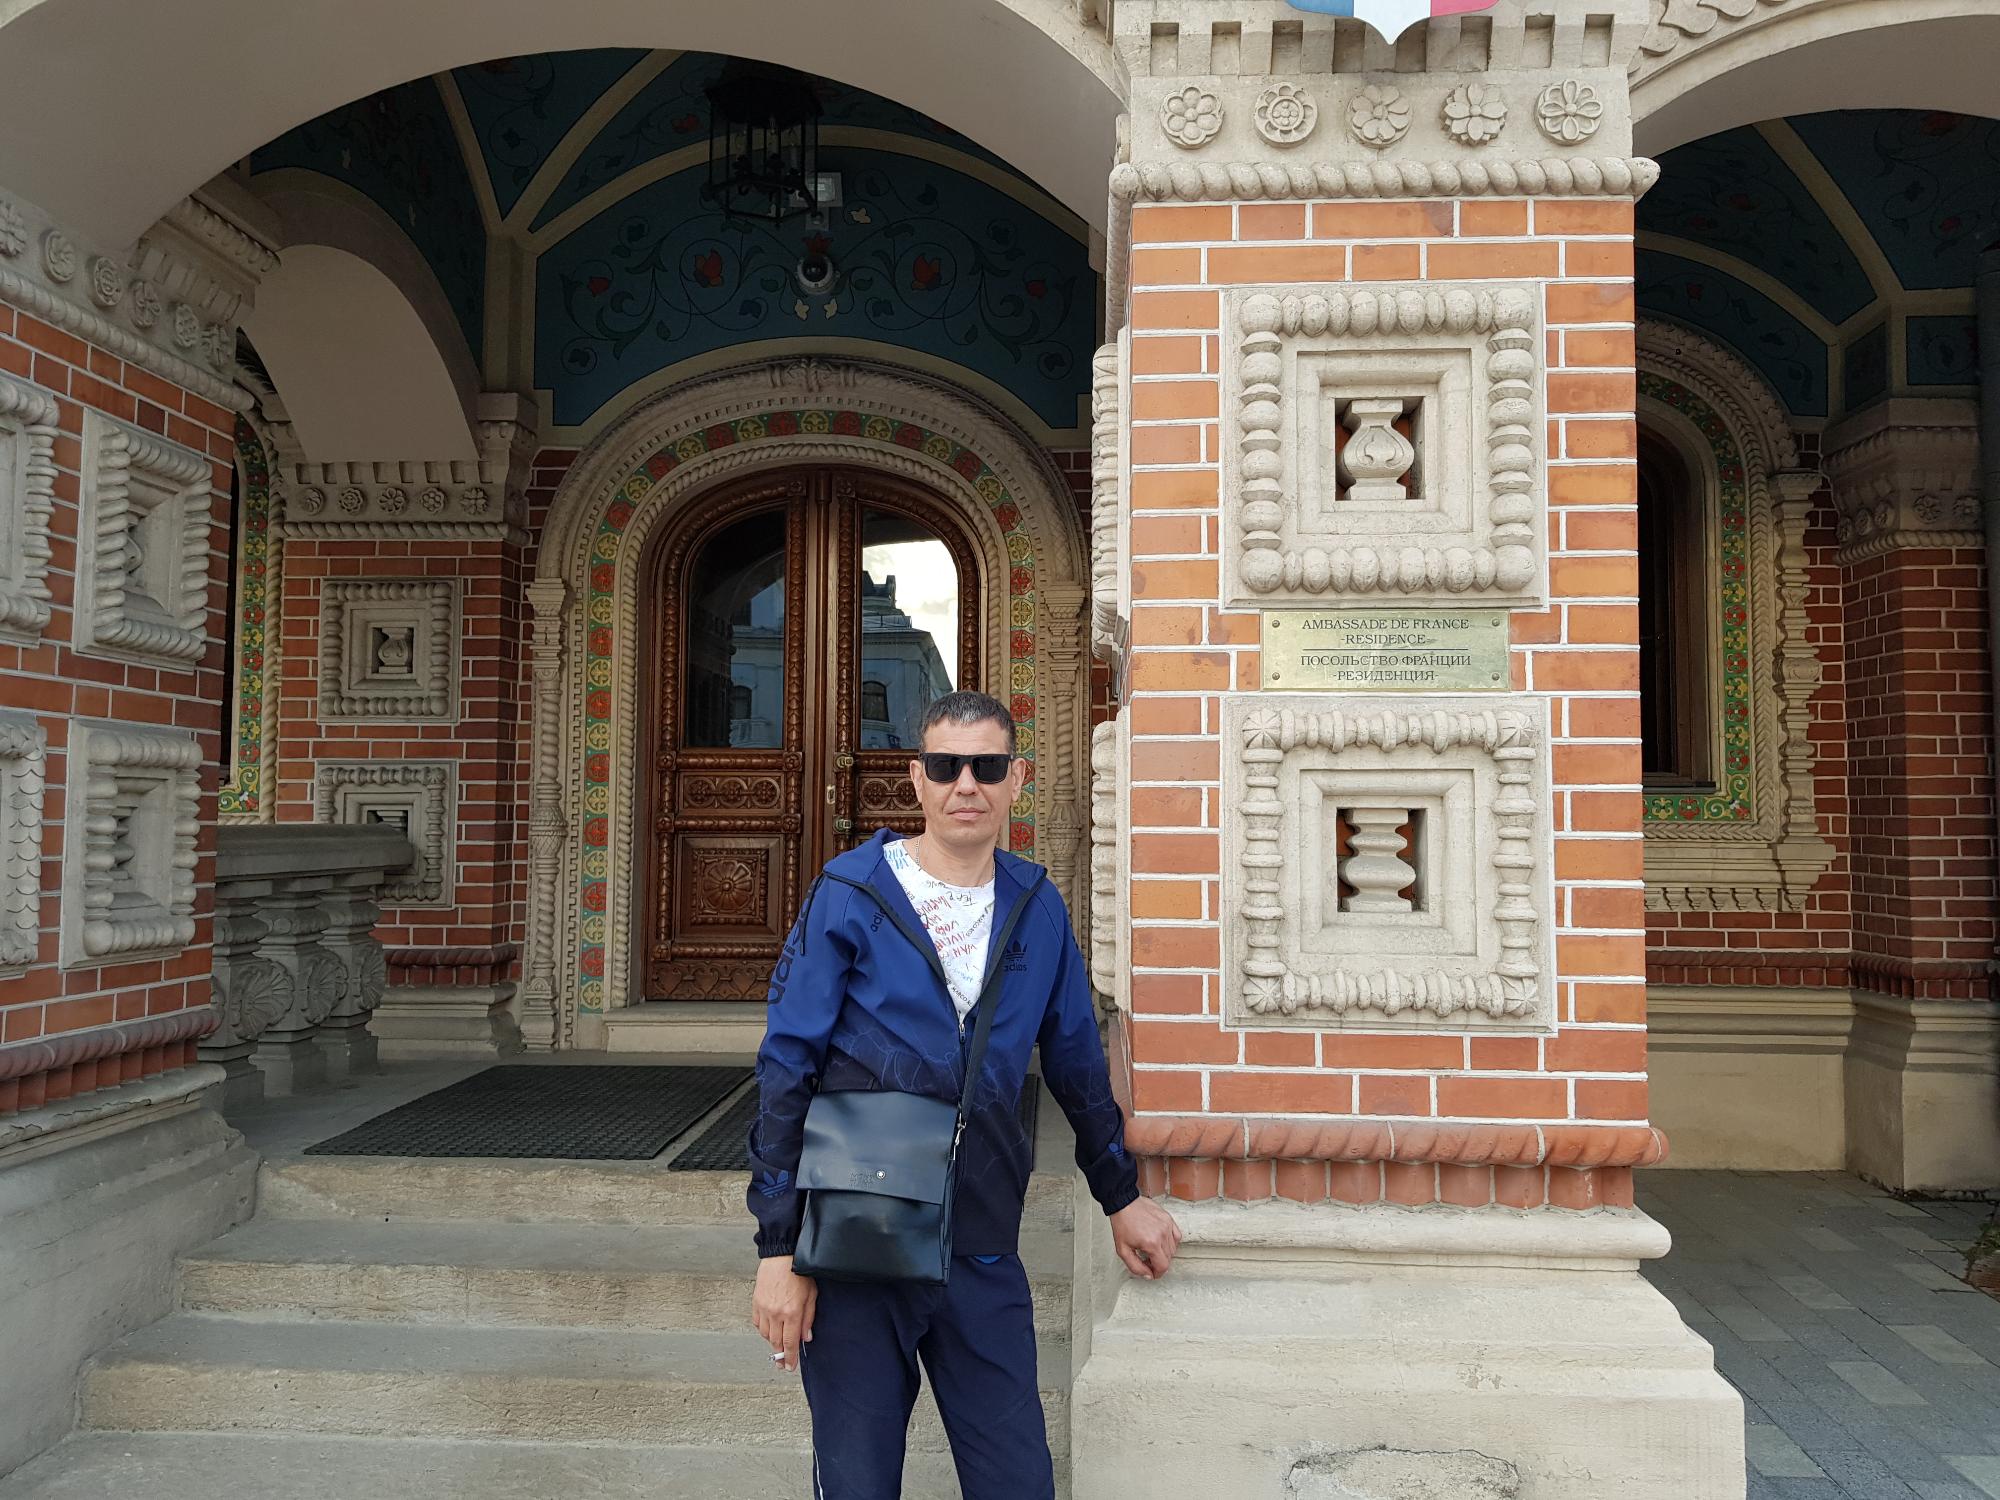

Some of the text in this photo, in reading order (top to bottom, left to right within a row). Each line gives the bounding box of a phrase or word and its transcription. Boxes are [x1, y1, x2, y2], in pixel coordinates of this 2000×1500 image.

[1302, 618, 1469, 630] AMBASSADE DE FRANCE
[1301, 655, 1471, 668] ПОСОЛЬСТВО ФРАНЦИИ
